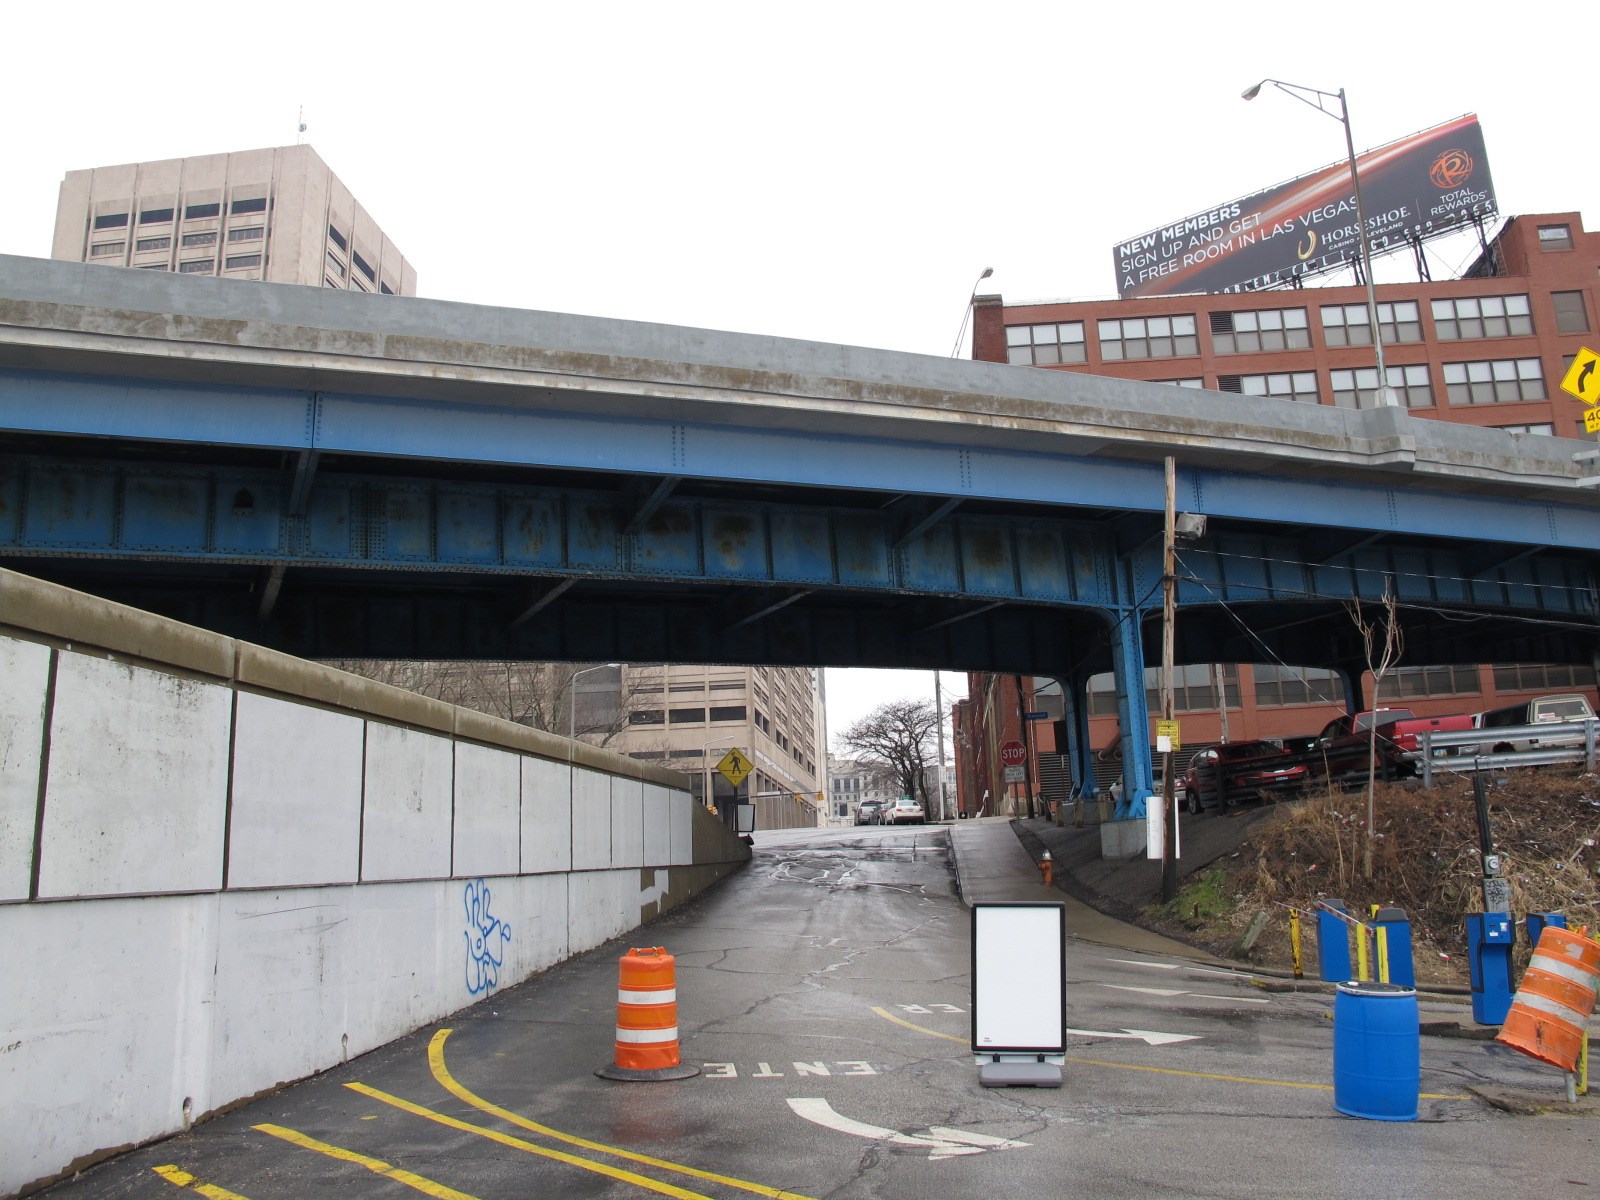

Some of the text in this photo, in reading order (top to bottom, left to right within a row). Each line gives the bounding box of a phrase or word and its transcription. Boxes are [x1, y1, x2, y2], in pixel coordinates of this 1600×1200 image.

[1430, 190, 1486, 216] REWARDS
[1440, 187, 1474, 204] TOTAL
[1120, 203, 1241, 258] NEW MEMBERS
[1321, 206, 1411, 245] HORSSHOE
[1328, 221, 1404, 251] CASINO LEVELAND
[1121, 212, 1262, 273] SIGN UP AND GET
[1123, 195, 1358, 289] A FREE ROOM IN LAS VEGAS
[1002, 748, 1025, 759] STOP
[703, 1060, 878, 1078] ENTE
